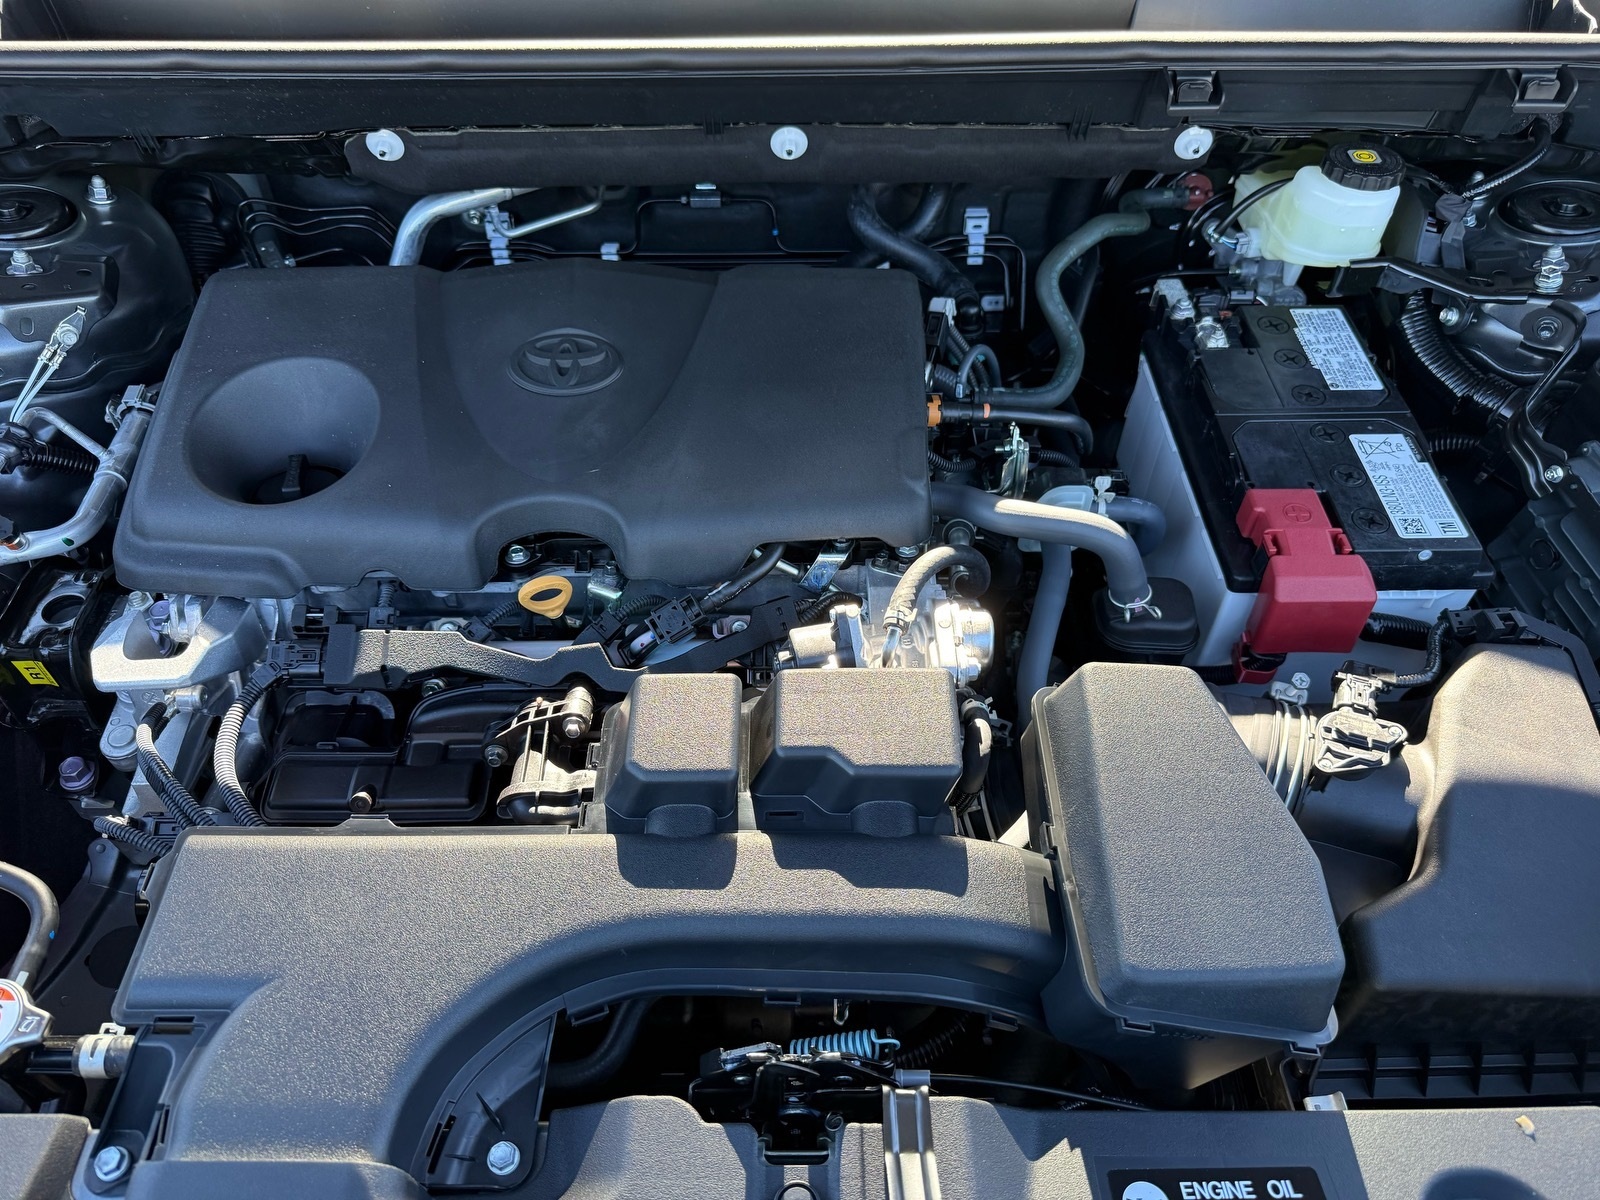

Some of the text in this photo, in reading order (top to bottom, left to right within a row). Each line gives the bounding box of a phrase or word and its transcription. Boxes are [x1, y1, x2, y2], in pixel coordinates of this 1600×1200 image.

[1371, 475, 1406, 515] 380LN3-ISS
[1438, 521, 1460, 534] TM
[23, 666, 45, 680] R1
[1179, 1179, 1304, 1200] ENGINE OIL
